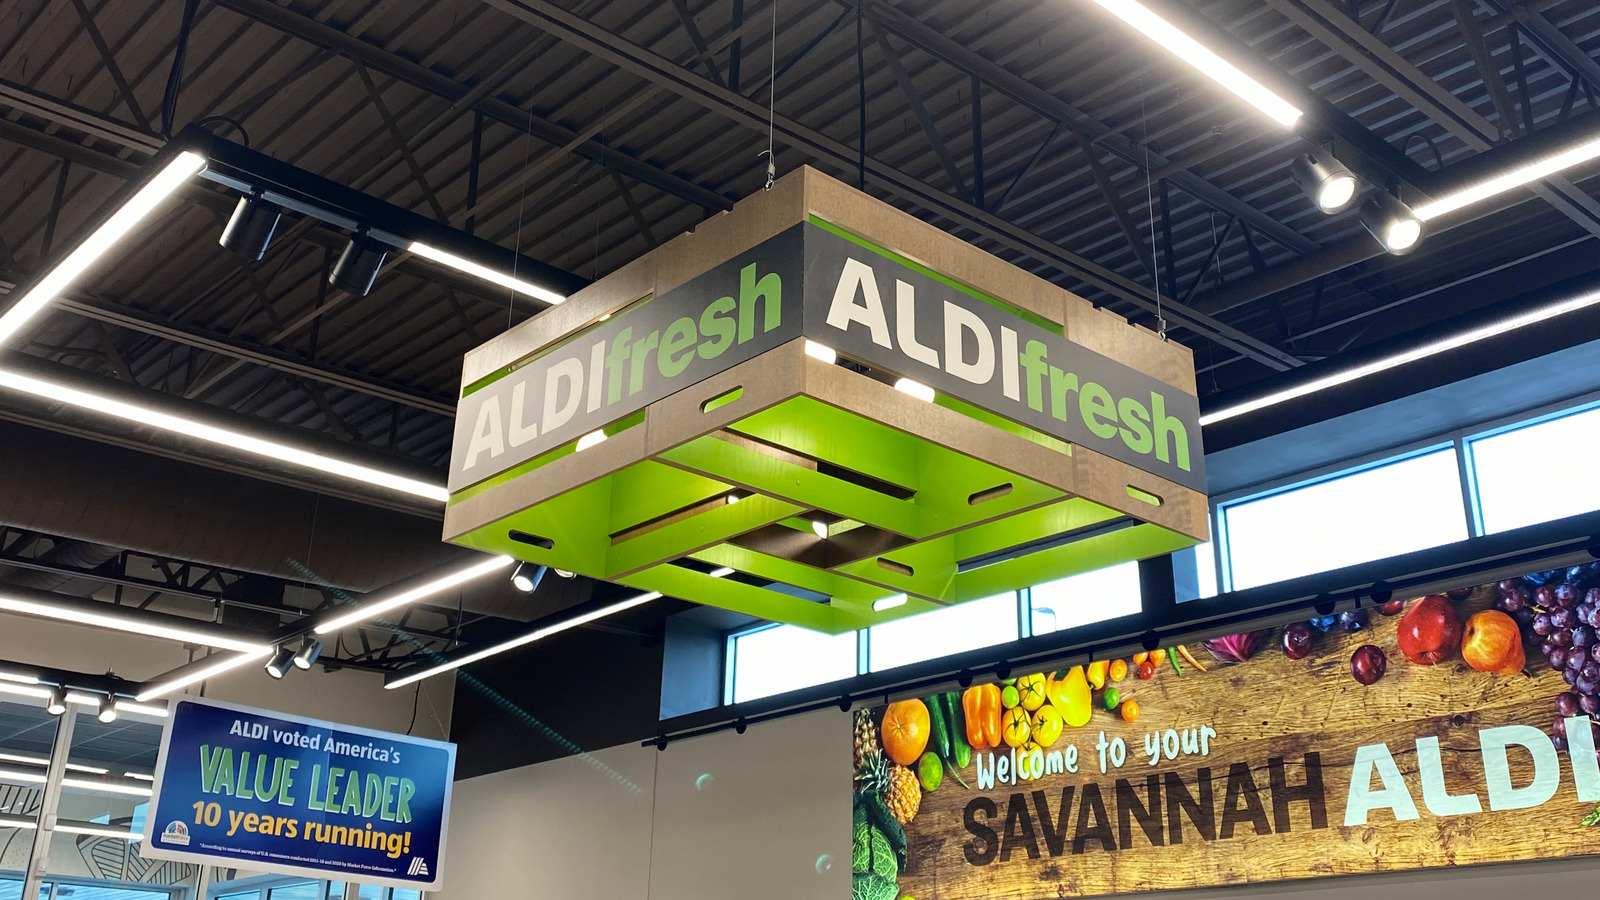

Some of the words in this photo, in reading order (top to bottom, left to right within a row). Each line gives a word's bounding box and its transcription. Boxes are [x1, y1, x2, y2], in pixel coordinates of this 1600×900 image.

[463, 262, 782, 471] ALDIfresh
[826, 257, 1191, 473] ALDIfresh
[230, 719, 268, 742] ALDI
[272, 729, 320, 750] voted
[324, 737, 401, 764] America's
[976, 743, 1079, 791] Welcome
[1096, 730, 1127, 774] to
[1145, 723, 1218, 767] your
[199, 744, 300, 807] VALUE
[308, 763, 417, 825] LEADER
[963, 752, 1329, 867] SAVANNAH
[1343, 715, 1600, 828] ALDI
[192, 801, 222, 827] 10
[227, 811, 298, 838] years
[304, 821, 412, 859] running!
